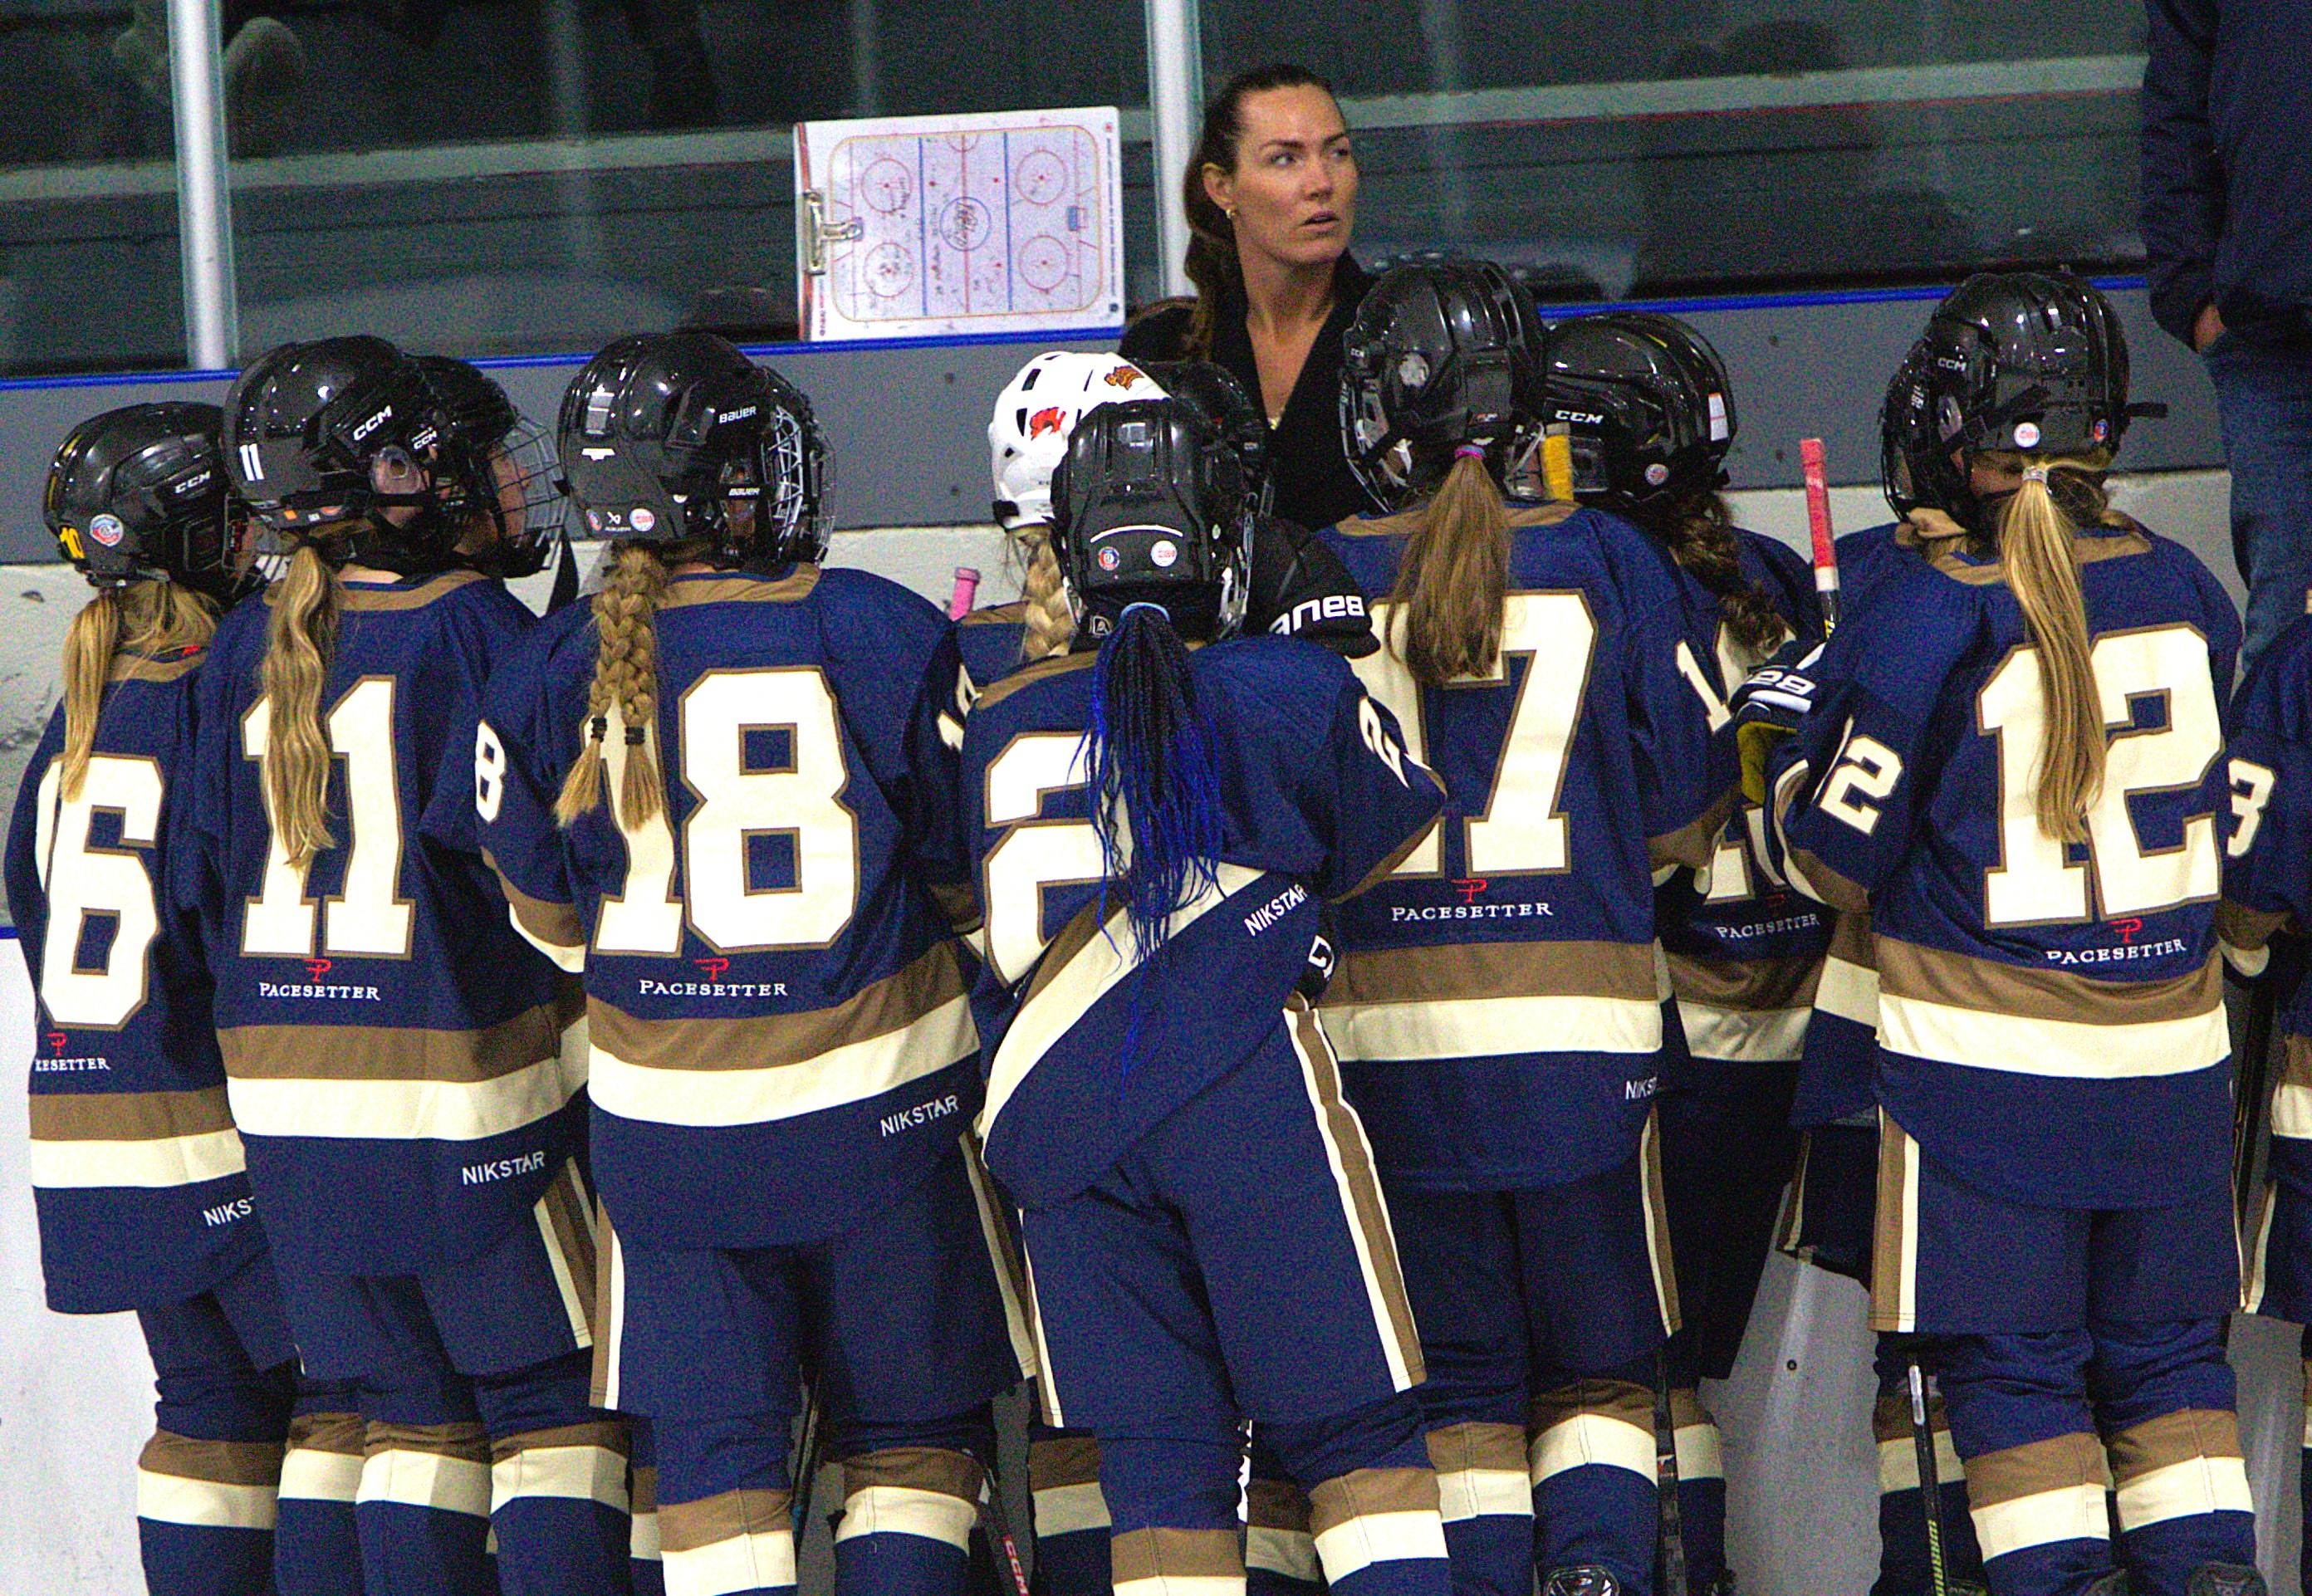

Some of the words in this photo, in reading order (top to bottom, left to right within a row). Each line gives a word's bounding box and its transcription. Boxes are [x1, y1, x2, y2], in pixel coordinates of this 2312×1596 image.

[1937, 357, 1967, 372] CCM
[353, 404, 393, 441] CCM
[1555, 409, 1604, 424] CCM
[414, 430, 438, 449] CCM
[174, 470, 211, 494] CCM
[474, 719, 506, 823] 8
[1976, 621, 2226, 929] 12
[240, 674, 415, 960] 11
[580, 665, 860, 957] 18
[35, 751, 163, 1031] 6
[1244, 884, 1308, 937] NIKSTAR
[1391, 903, 1553, 922] PACESETTER
[1714, 913, 1820, 939] PACESETTER
[2045, 938, 2187, 965] PACESETTER
[258, 982, 381, 1001] PACESETTER
[639, 979, 788, 997] PACESETTER
[880, 1094, 958, 1137] NIKSTAR
[462, 1150, 545, 1185] NIKSTAR
[203, 1196, 255, 1226] NIKS
